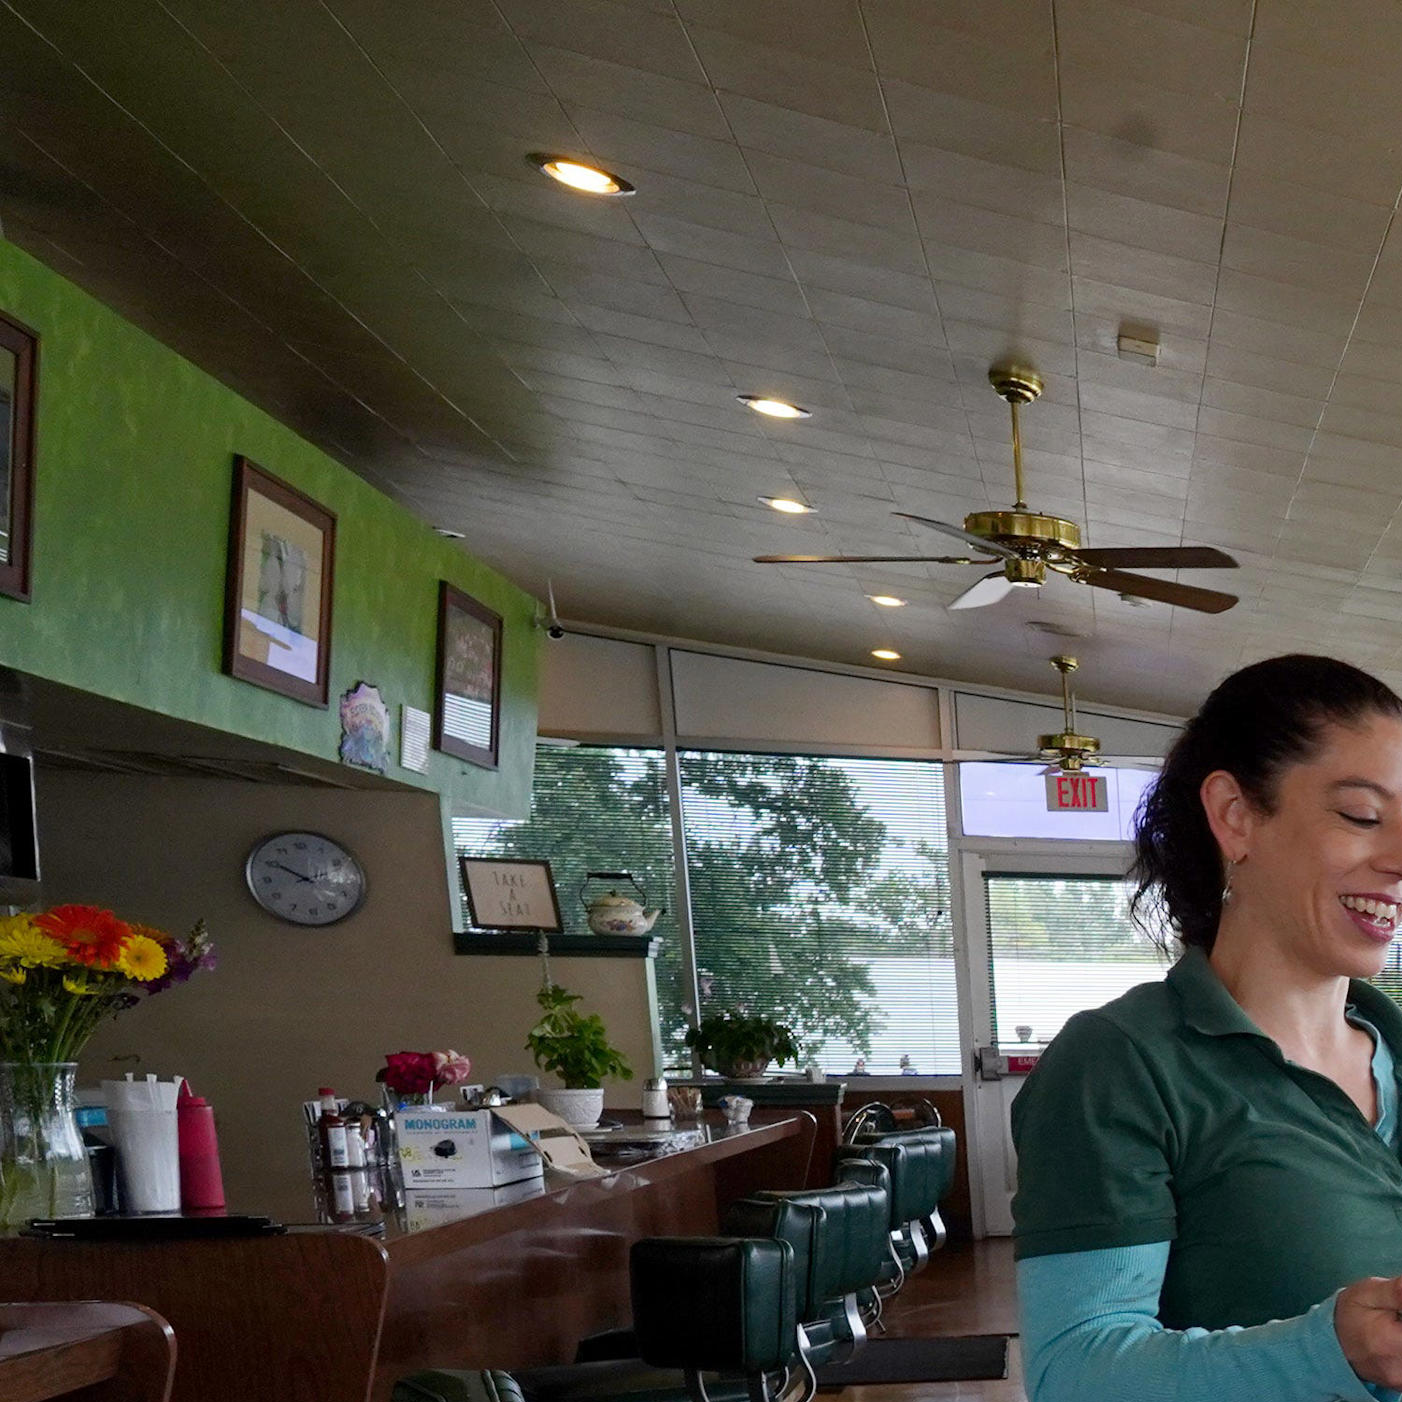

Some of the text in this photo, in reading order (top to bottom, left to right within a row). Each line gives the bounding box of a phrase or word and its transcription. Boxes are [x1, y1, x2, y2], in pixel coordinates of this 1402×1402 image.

[1056, 777, 1098, 808] EXIT
[492, 871, 529, 888] TAKE
[510, 888, 516, 900] A
[501, 900, 531, 916] SEAT
[404, 1119, 477, 1131] MONOGRAM
